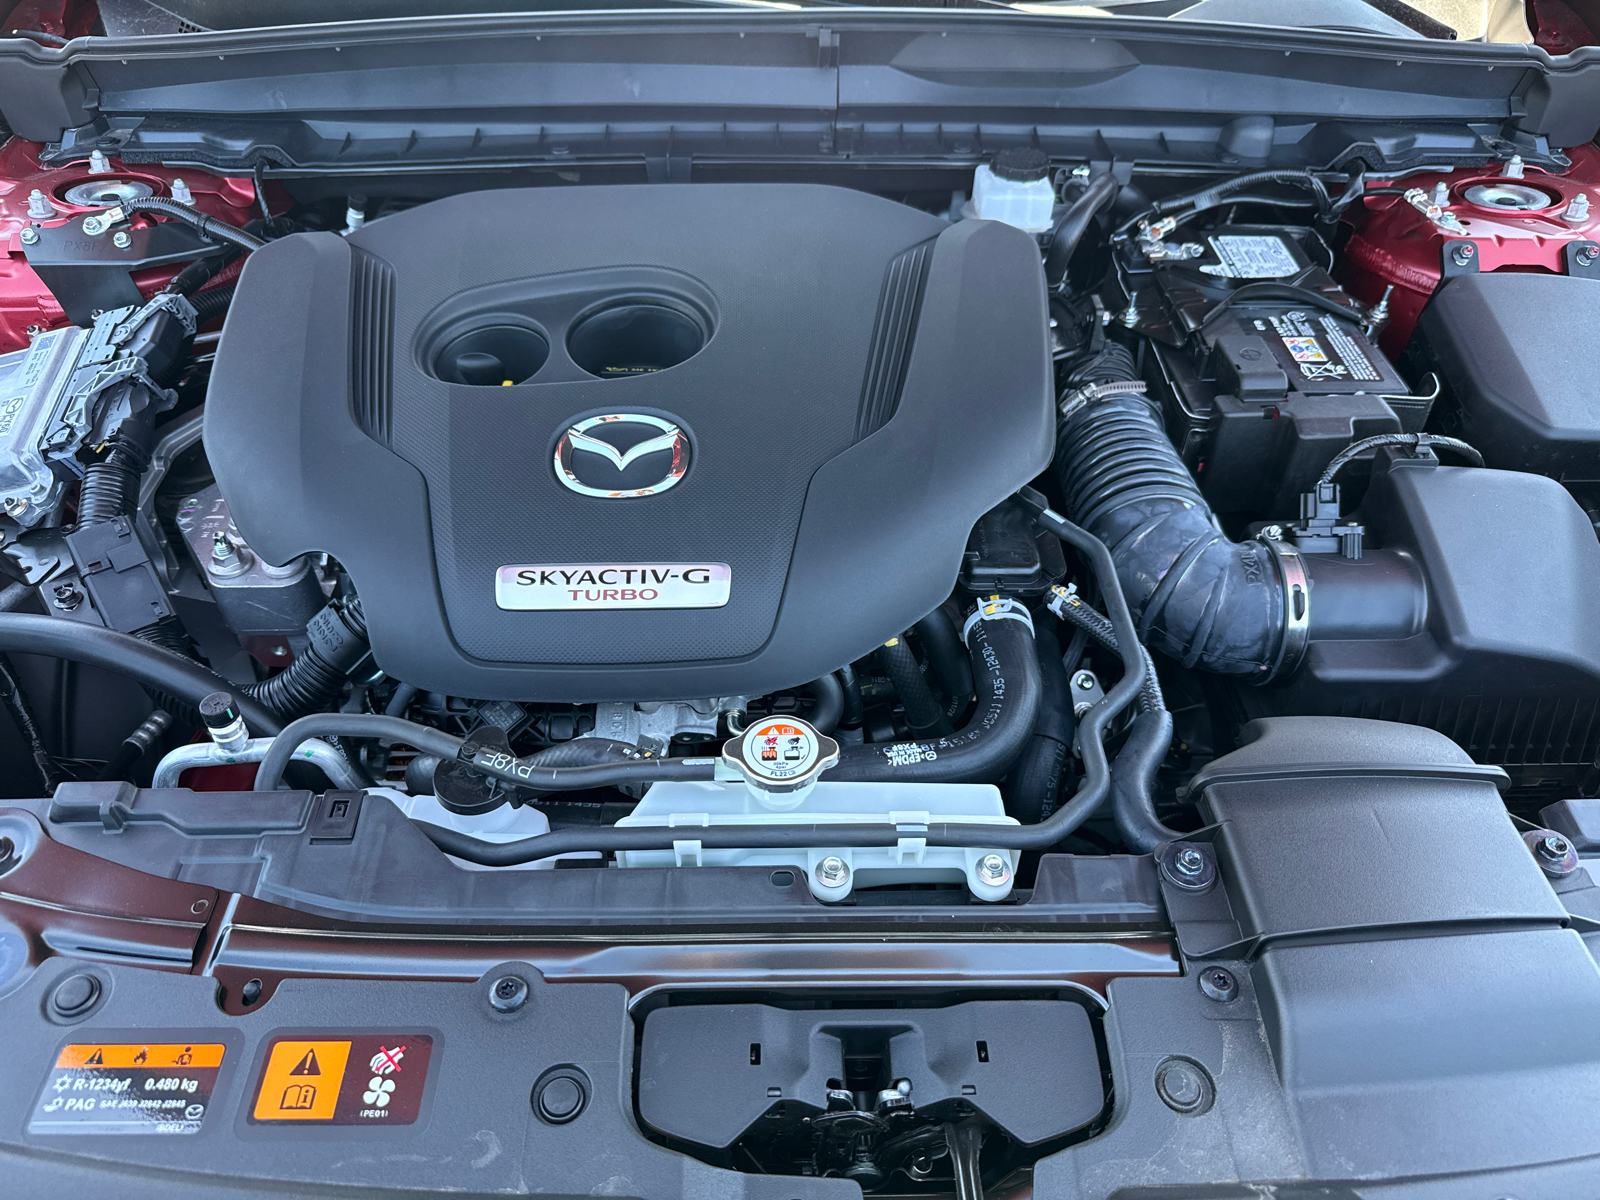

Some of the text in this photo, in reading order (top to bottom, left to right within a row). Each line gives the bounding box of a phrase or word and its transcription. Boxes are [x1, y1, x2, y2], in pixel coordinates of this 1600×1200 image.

[516, 568, 710, 586] SKYACTIV-G
[567, 588, 659, 601] TURBO
[992, 677, 1005, 700] 1435
[480, 752, 536, 779] PX8F
[72, 1077, 199, 1094] R-1234yf 0.480 kg
[64, 1098, 96, 1111] PAG
[360, 1109, 389, 1118] (PE01)
